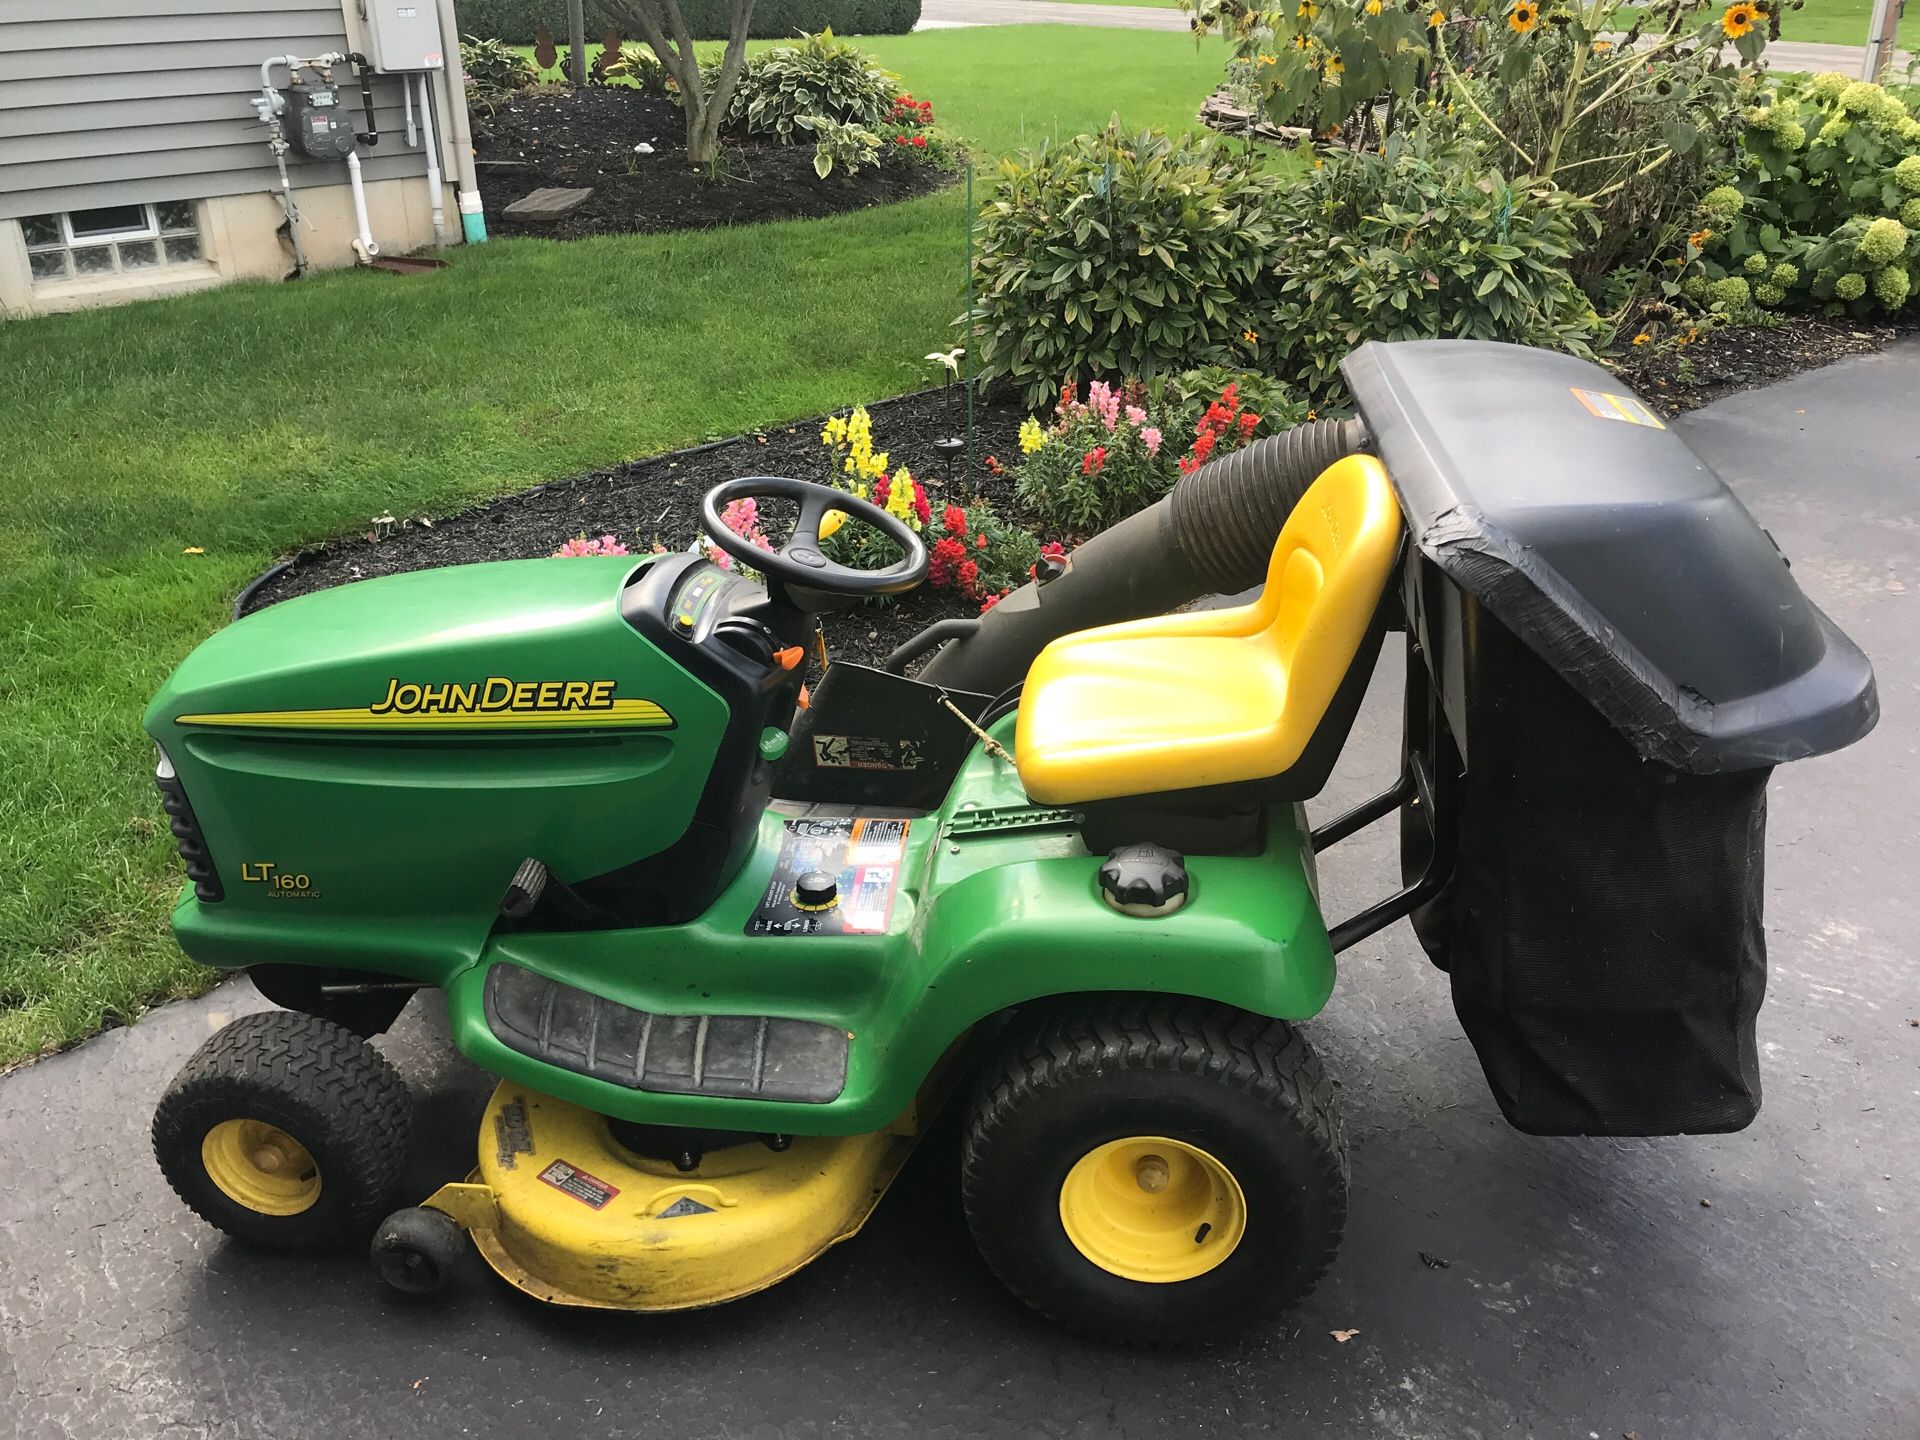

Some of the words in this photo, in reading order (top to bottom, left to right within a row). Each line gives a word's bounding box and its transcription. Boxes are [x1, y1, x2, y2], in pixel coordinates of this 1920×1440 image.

[371, 678, 479, 713] JOHN
[479, 676, 618, 712] DEERE
[241, 863, 275, 881] LT
[272, 874, 311, 889] 160
